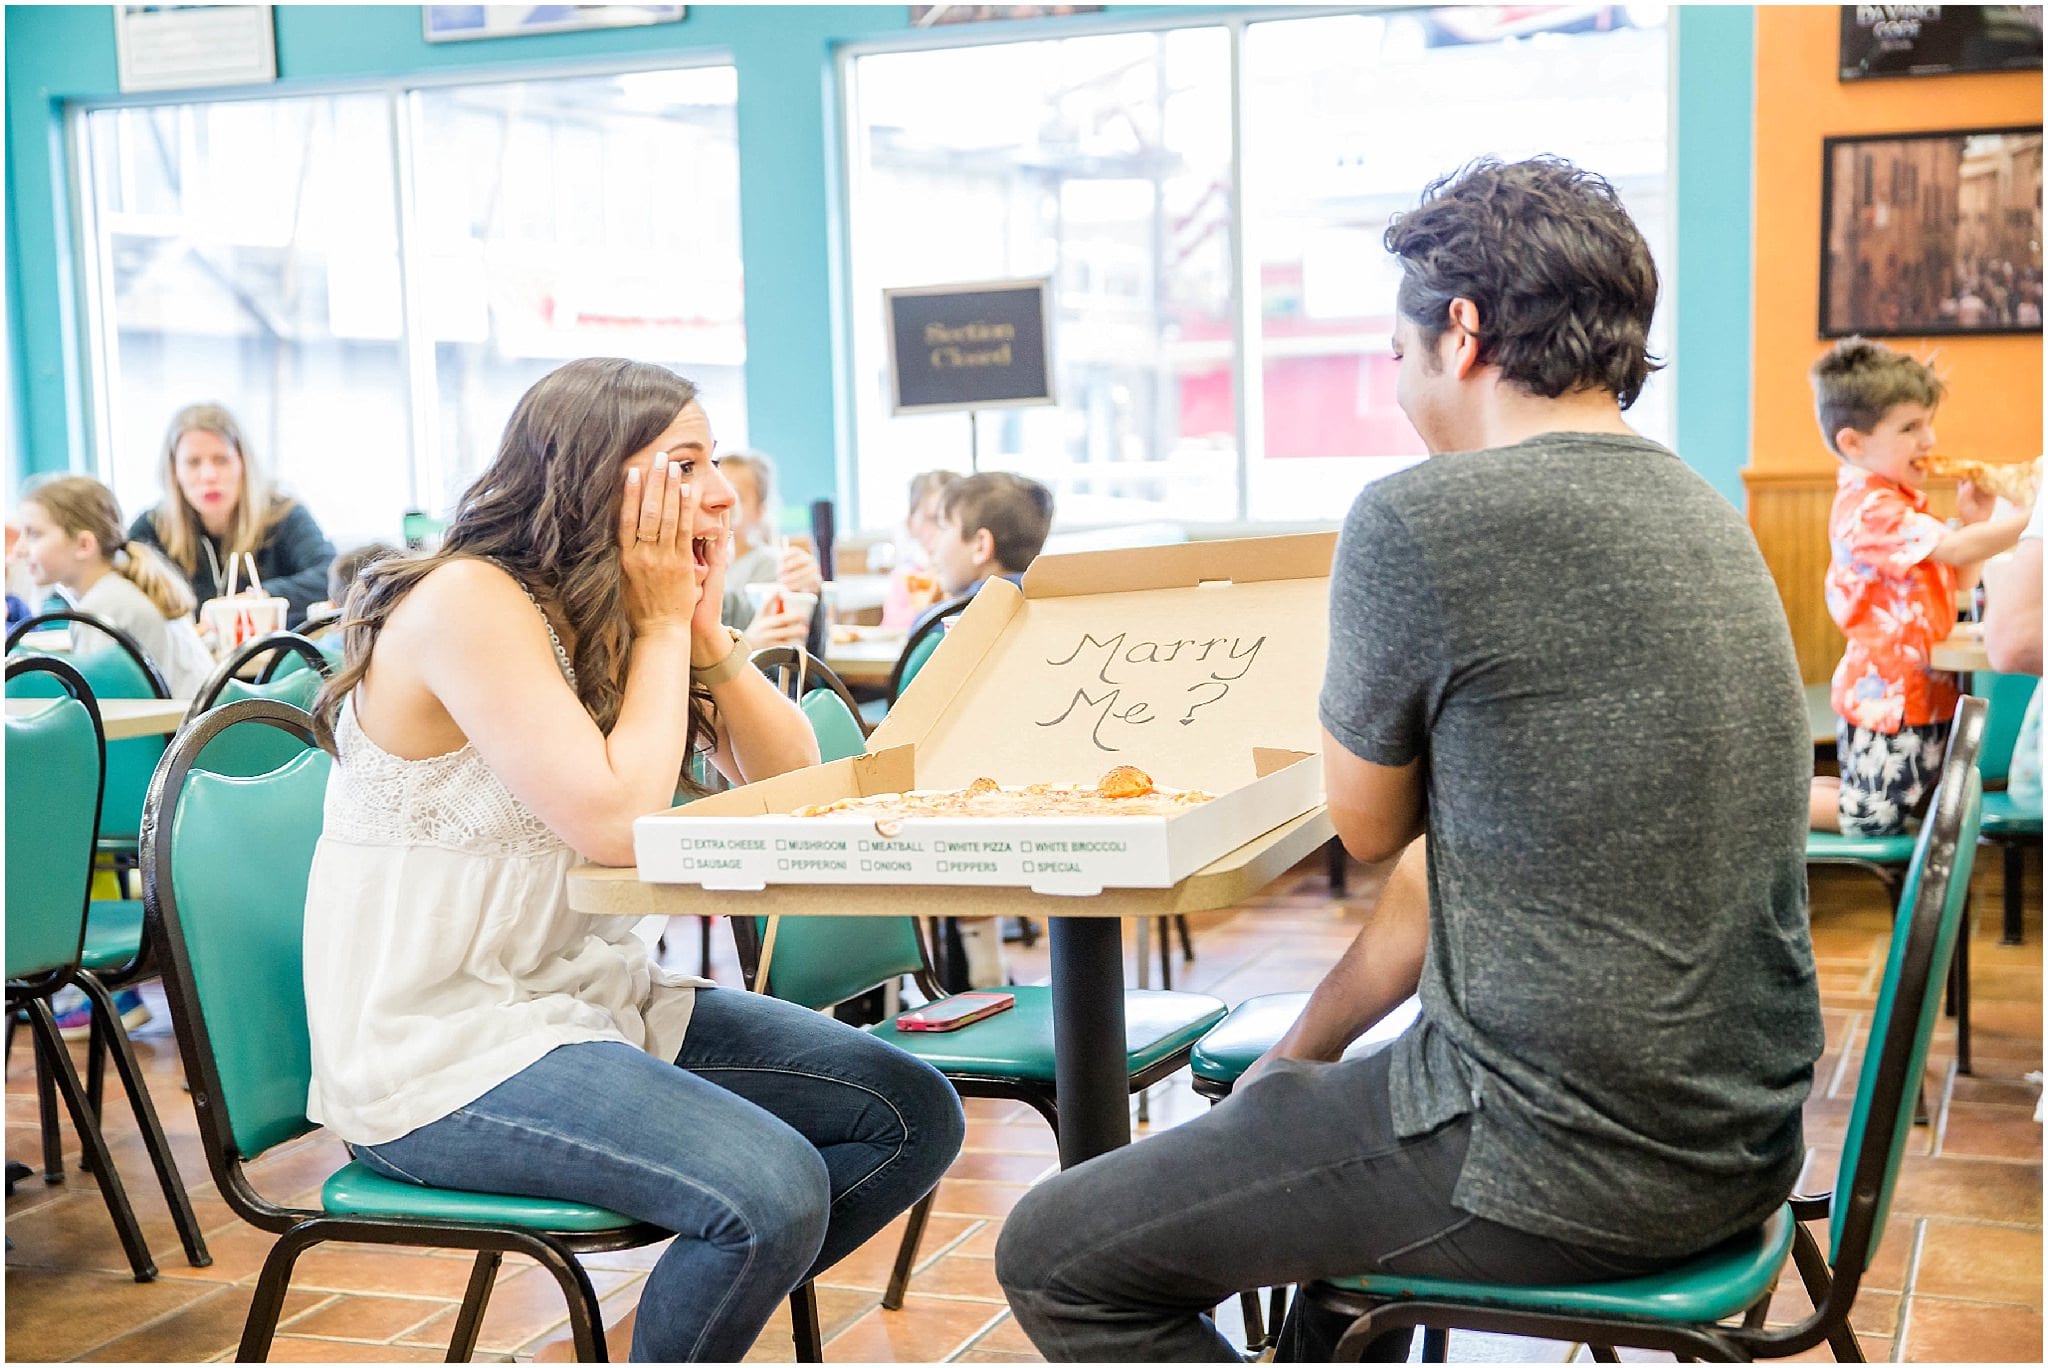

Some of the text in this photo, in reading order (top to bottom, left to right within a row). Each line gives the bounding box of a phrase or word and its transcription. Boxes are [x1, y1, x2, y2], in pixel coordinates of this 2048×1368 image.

[1046, 632, 1266, 684] Marry
[694, 839, 767, 851] EXTRA CHEESE
[788, 840, 847, 851] MUSHROOM
[871, 841, 924, 852] MEATBALL
[947, 841, 1013, 852] WHITE PIZZA
[1034, 841, 1128, 853] WHITE BROCCOLI
[697, 859, 743, 870] SAUSAGE
[790, 859, 848, 871] PEPPERONI
[873, 860, 913, 872] ONIONS
[949, 860, 998, 873] PEPPERS
[1037, 861, 1083, 874] SPECIAL
